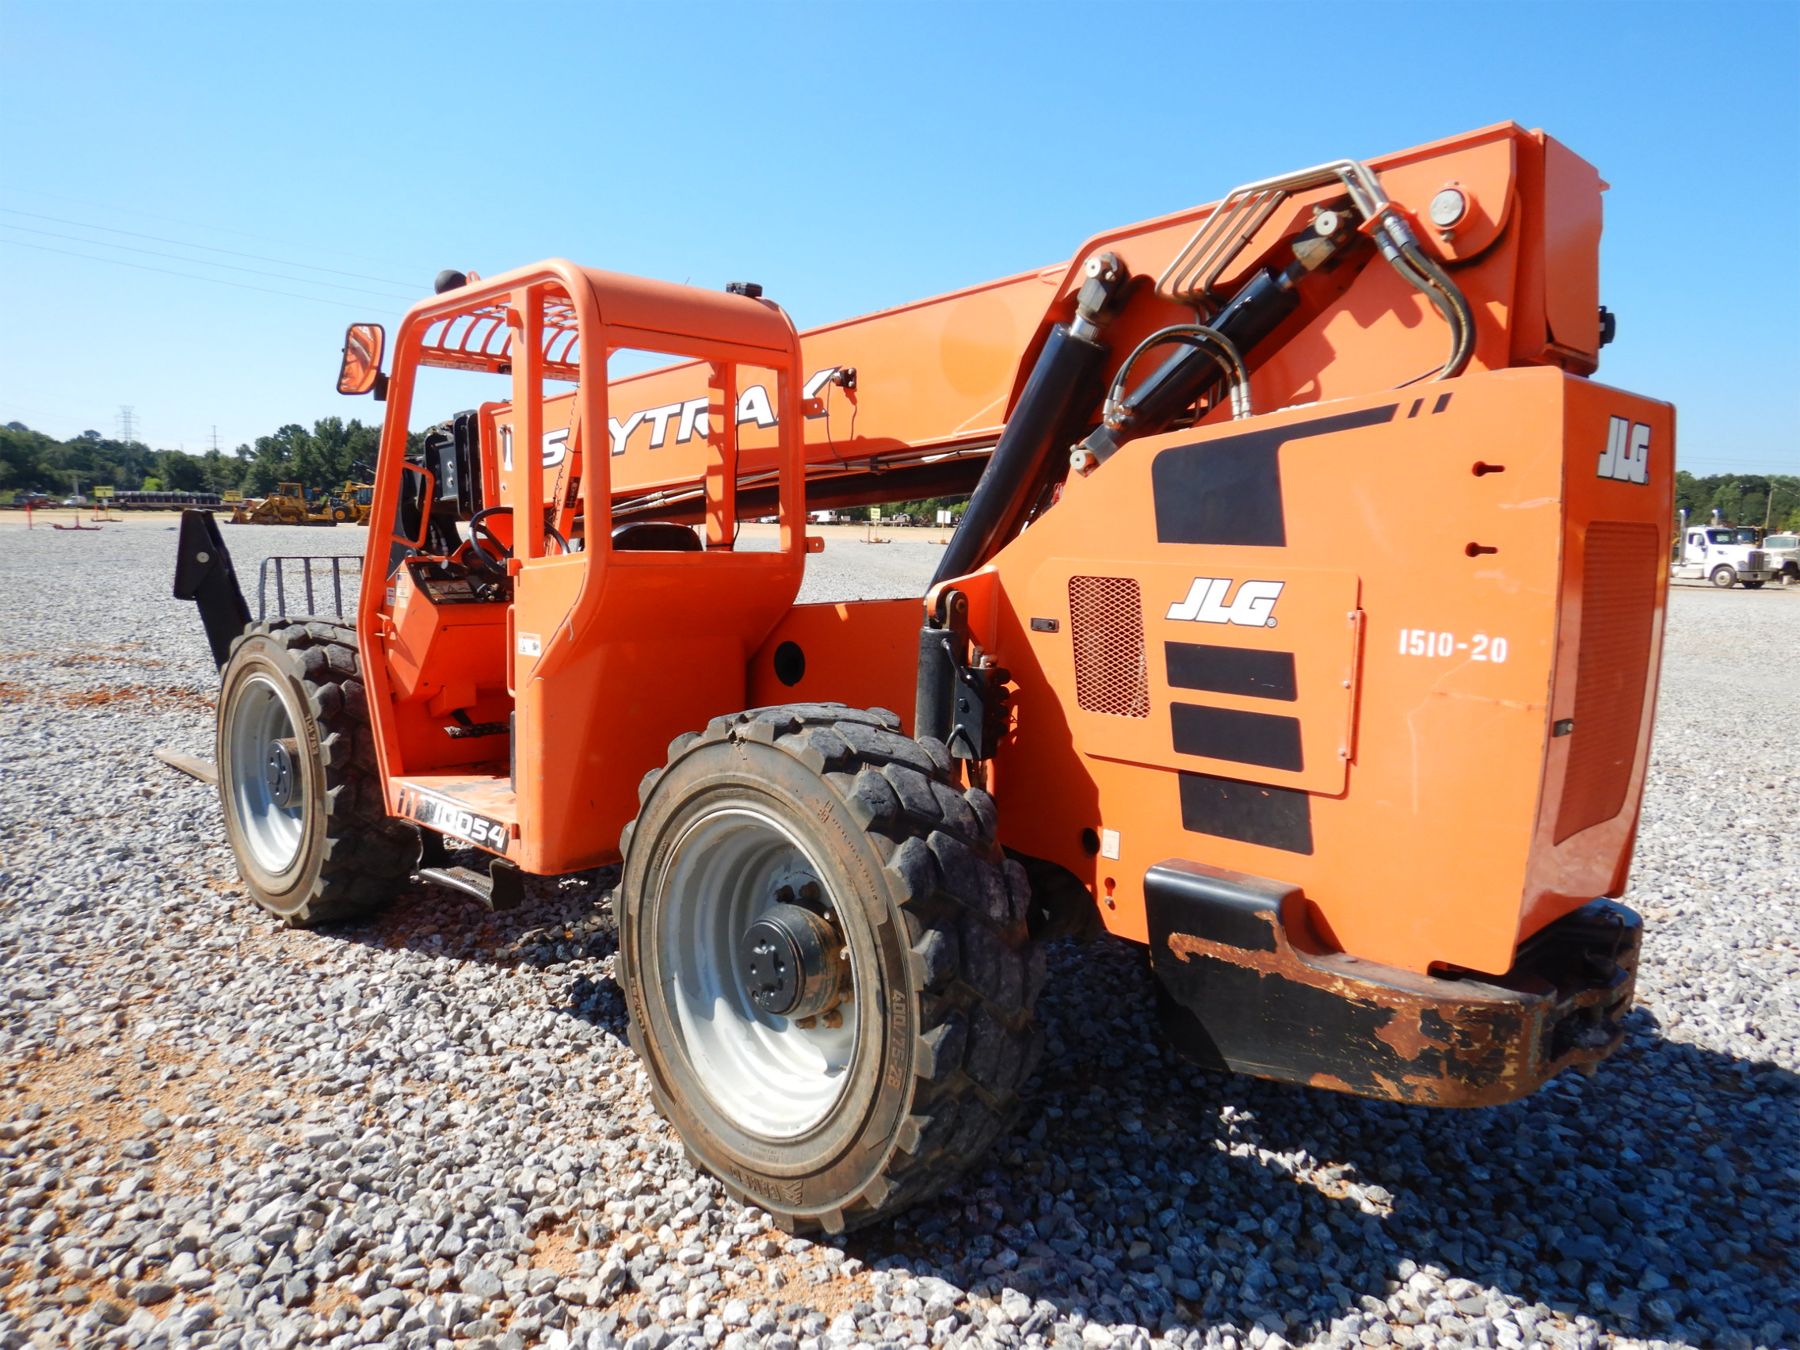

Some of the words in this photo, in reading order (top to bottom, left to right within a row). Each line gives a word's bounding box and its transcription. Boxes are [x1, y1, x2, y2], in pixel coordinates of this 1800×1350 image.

[542, 365, 842, 469] SYTRA
[1597, 414, 1651, 486] JLG
[1165, 576, 1285, 627] JLG
[1398, 628, 1507, 663] 1510-20
